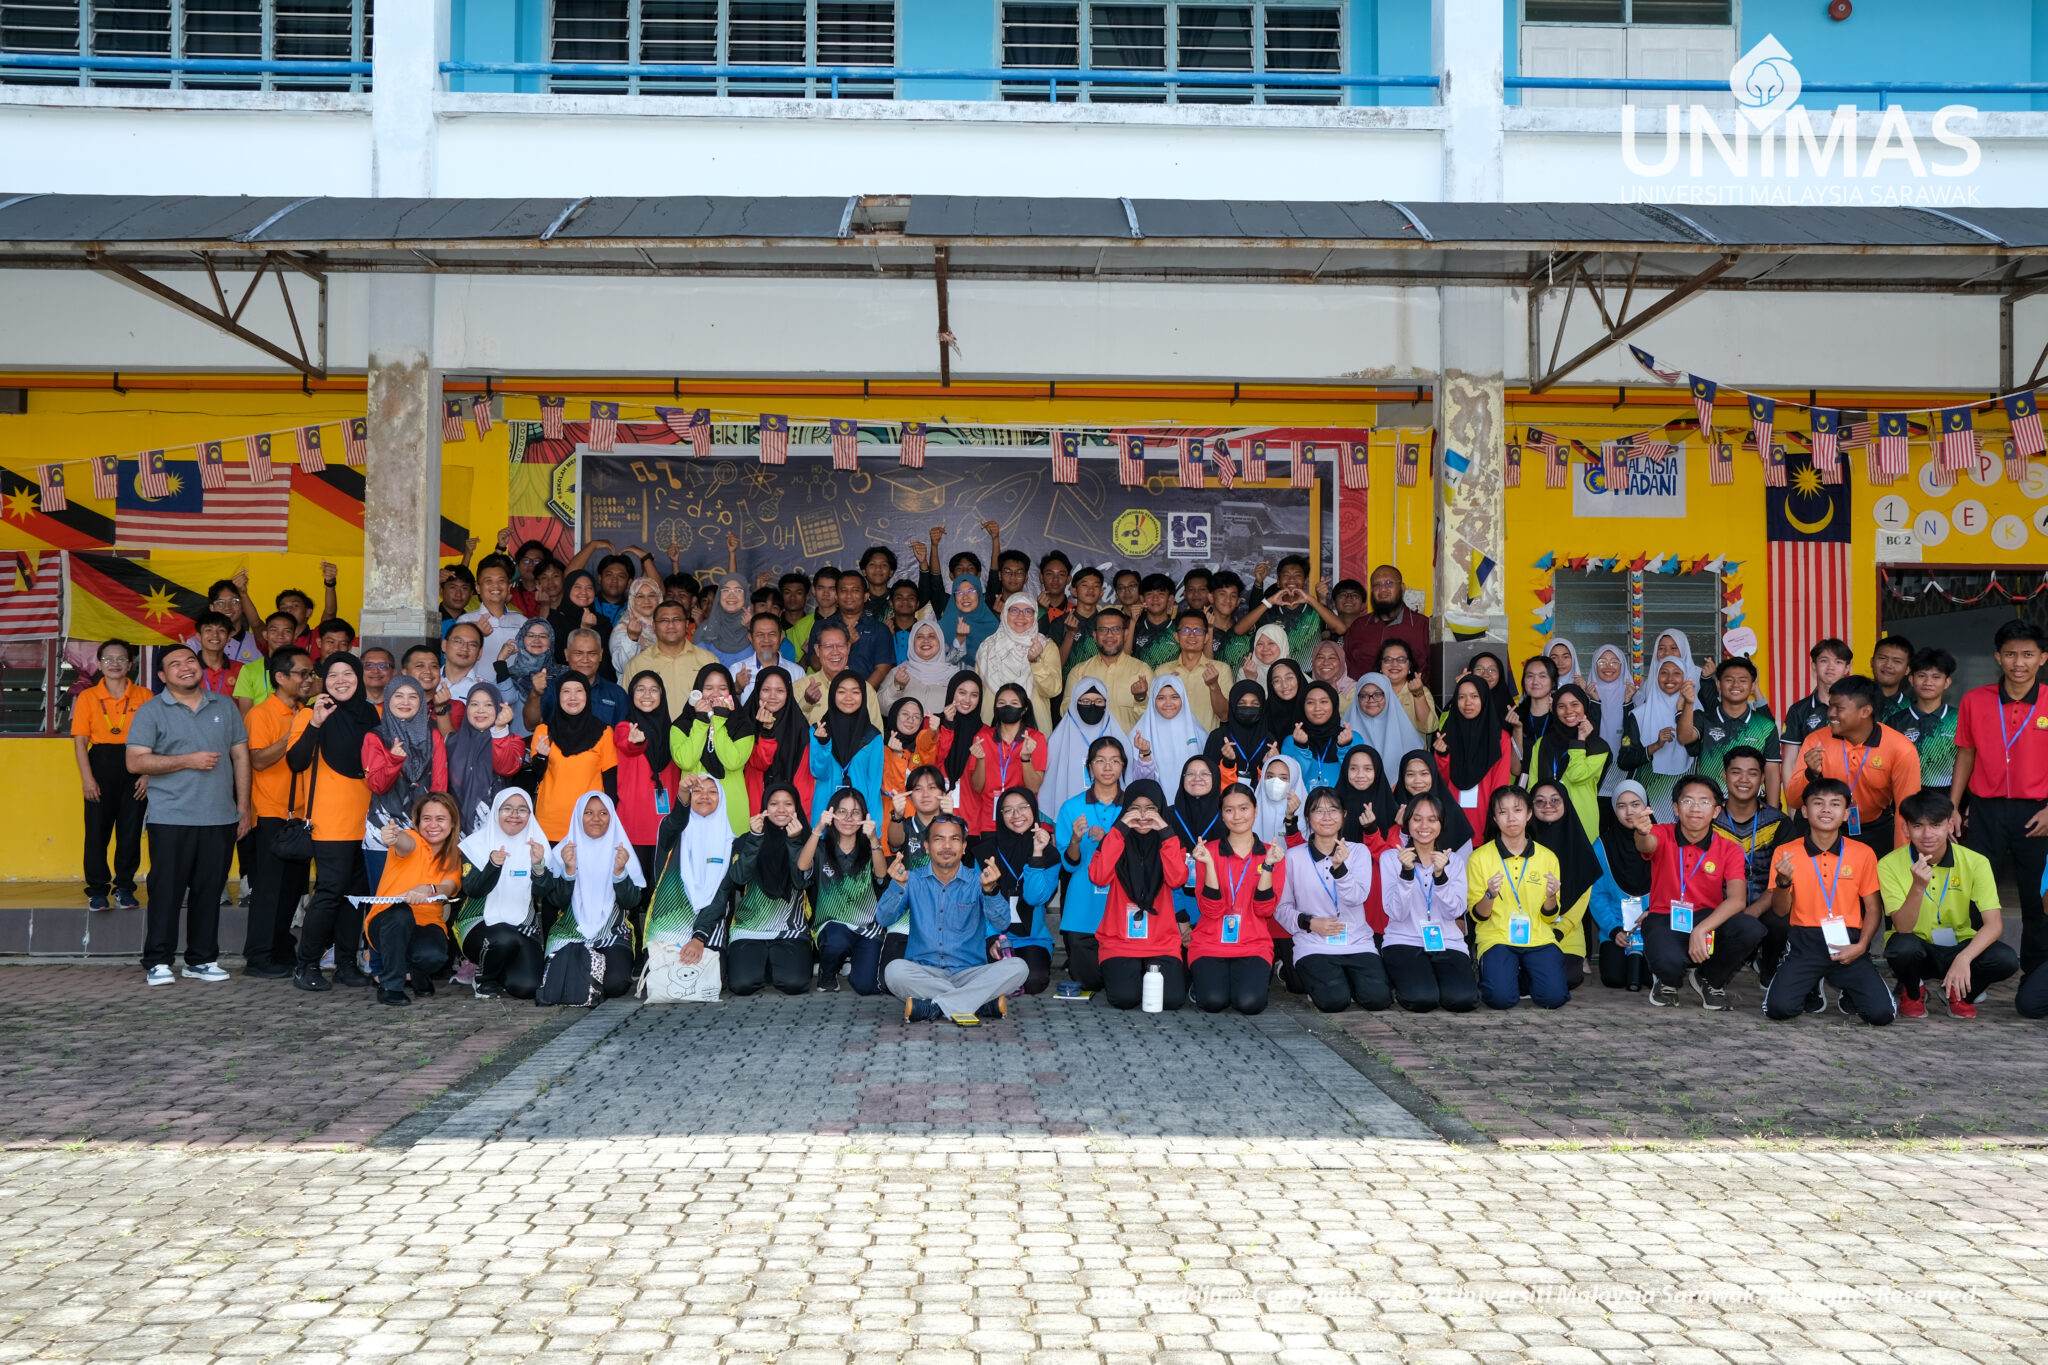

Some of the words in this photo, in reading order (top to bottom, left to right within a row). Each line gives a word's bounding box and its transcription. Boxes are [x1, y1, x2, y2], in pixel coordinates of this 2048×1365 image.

[1628, 457, 1678, 475] ALAYSIA
[1886, 536, 1901, 546] BC
[1904, 536, 1911, 546] 2
